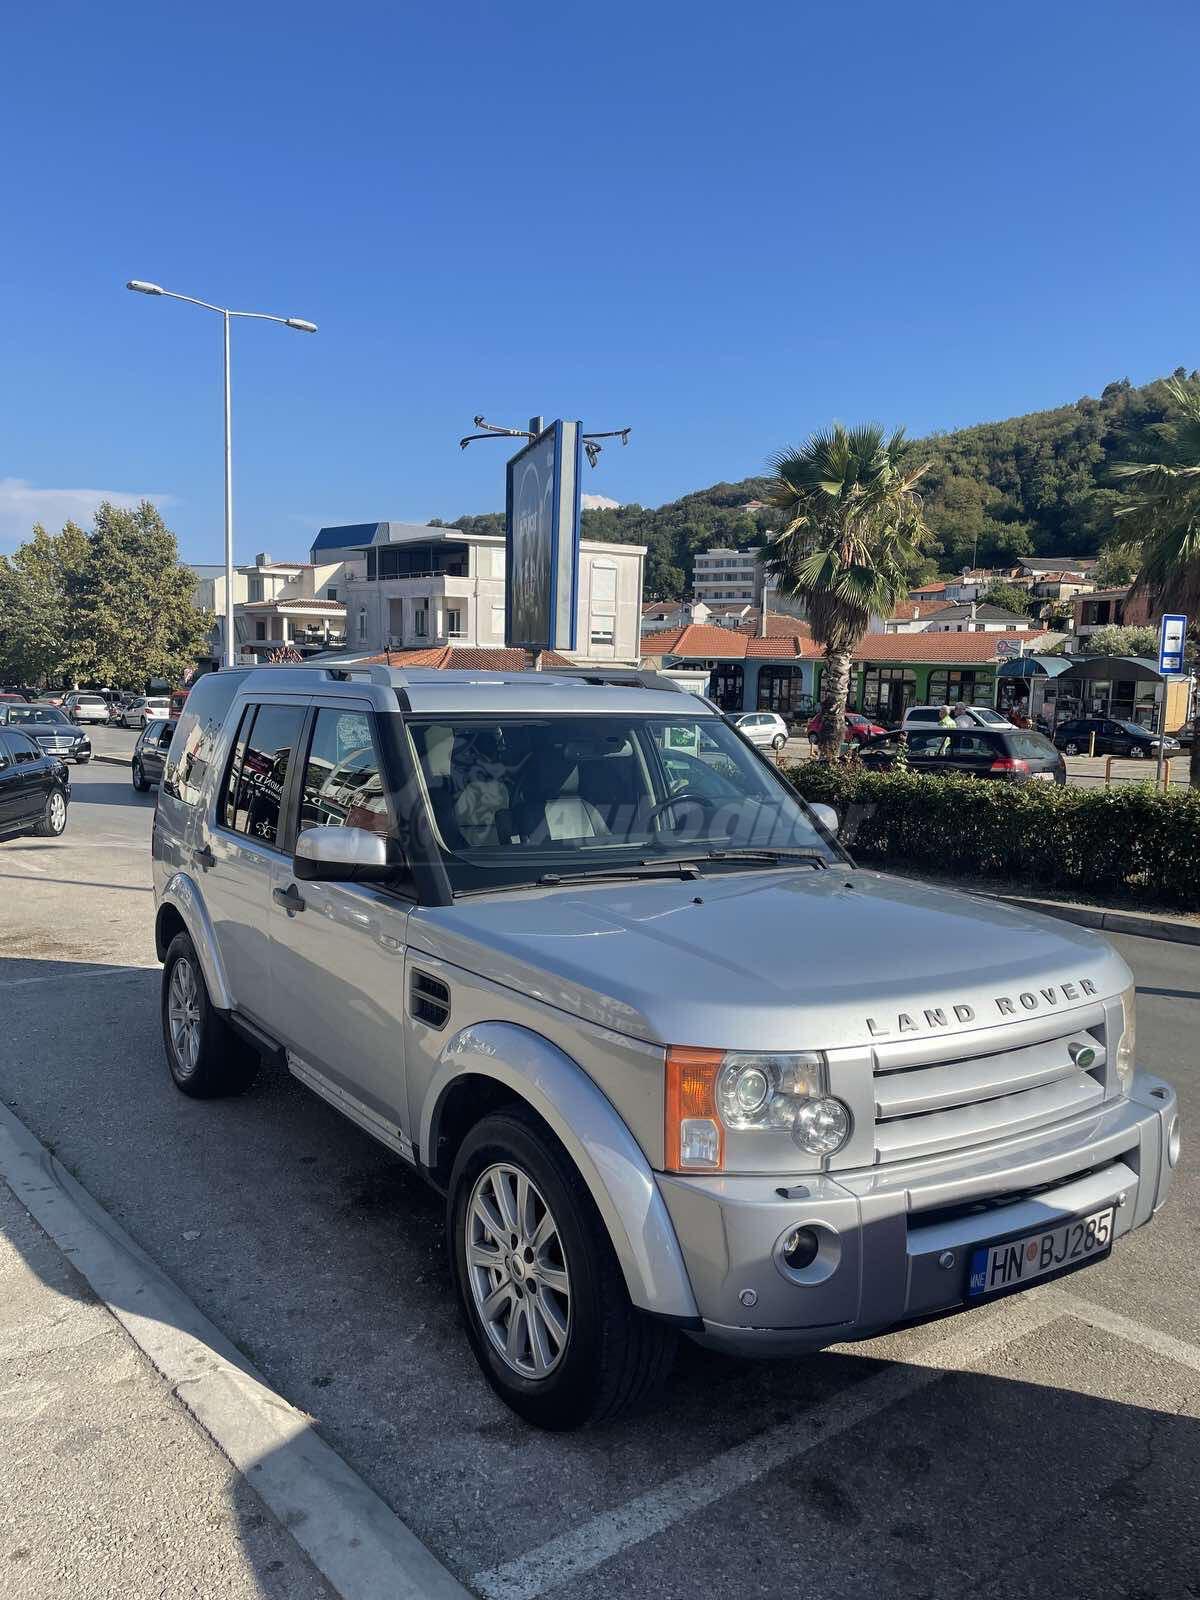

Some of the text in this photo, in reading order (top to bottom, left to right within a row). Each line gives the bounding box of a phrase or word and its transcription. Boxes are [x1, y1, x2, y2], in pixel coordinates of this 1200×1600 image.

[866, 978, 1098, 1036] LAND ROVER
[990, 1212, 1111, 1286] HN BJ285
[970, 1272, 986, 1289] MNE
